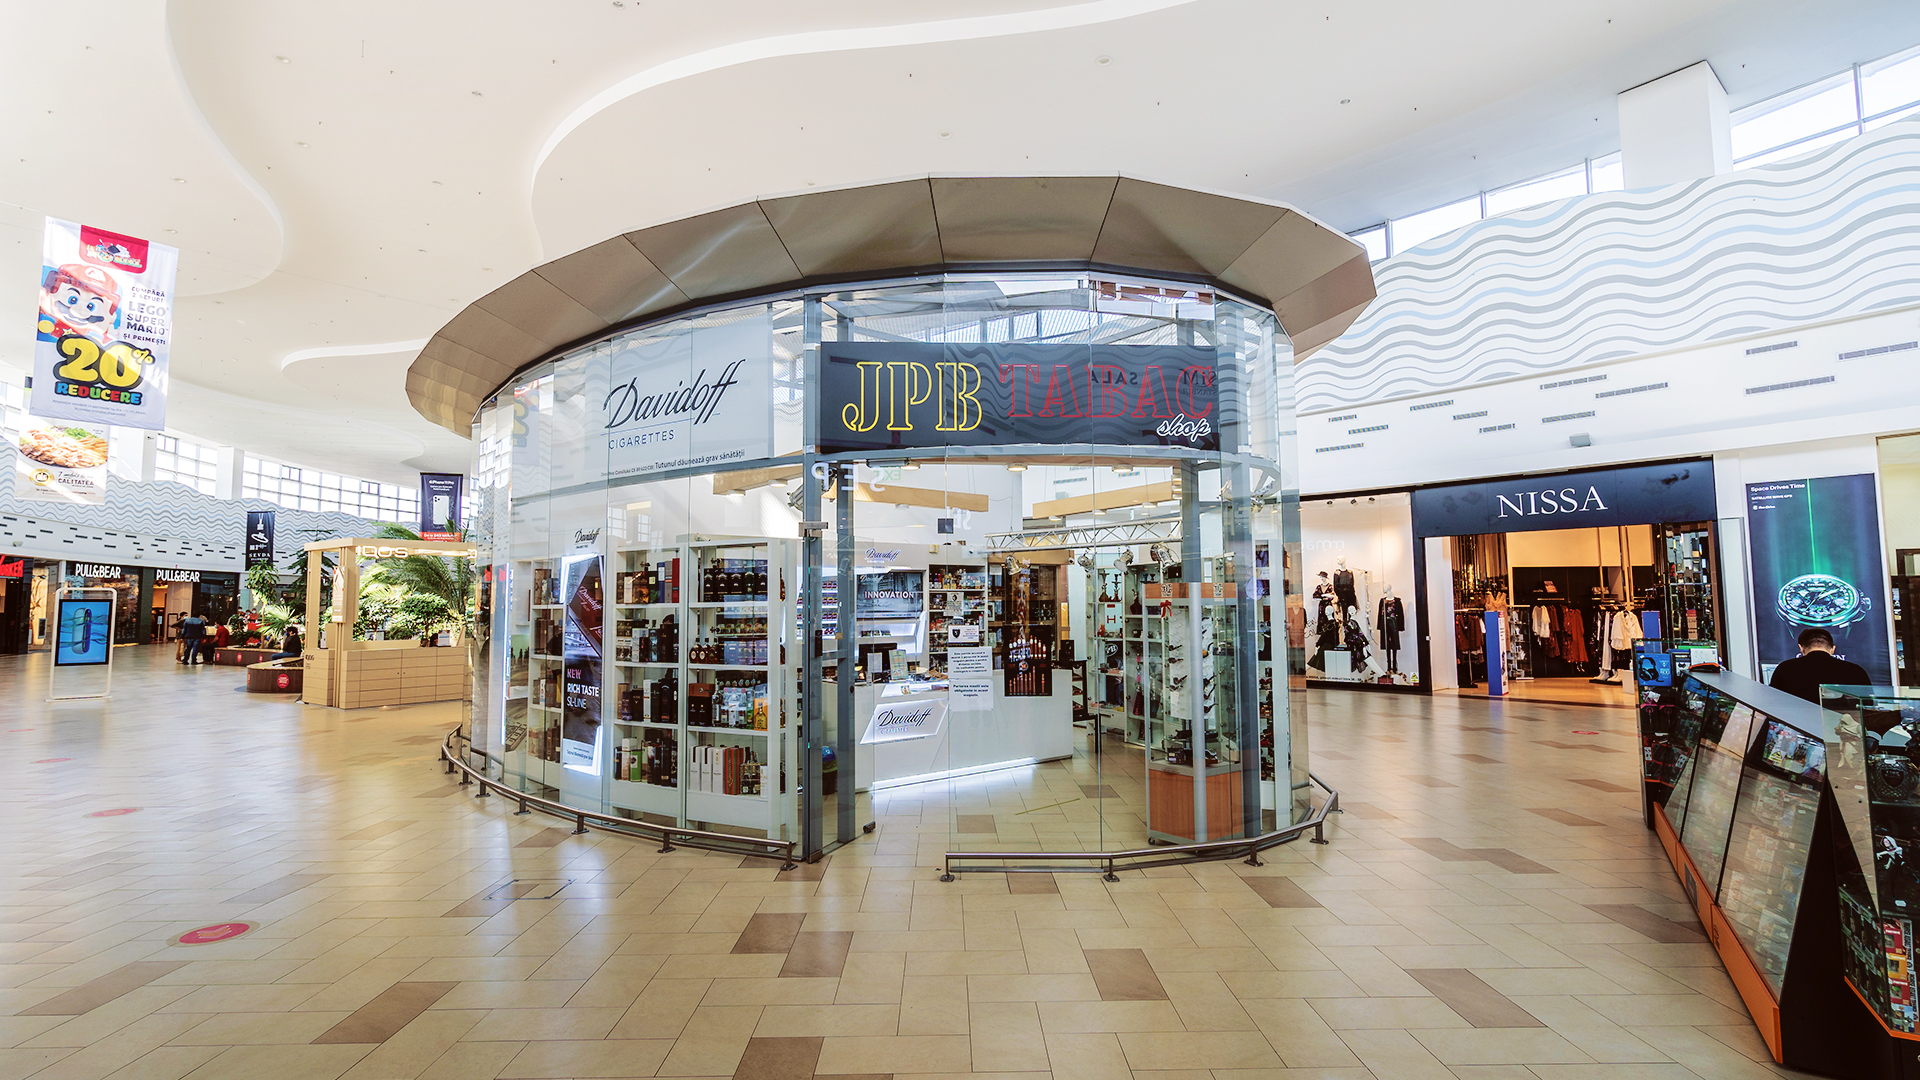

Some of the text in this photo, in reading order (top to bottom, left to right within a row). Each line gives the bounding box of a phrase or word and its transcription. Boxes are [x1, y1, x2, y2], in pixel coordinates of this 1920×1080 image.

[126, 313, 165, 327] SUPER
[55, 382, 142, 405] REDUCERE
[603, 358, 746, 429] Davidoff
[841, 361, 1213, 432] JPB TABAC
[1156, 413, 1211, 442] shop
[608, 429, 676, 450] CIGARETTES
[655, 459, 677, 469] Tutunul
[706, 454, 718, 465] grav
[58, 478, 94, 486] CALITATEA
[1496, 485, 1608, 519] NISSA
[356, 545, 409, 560] IQOS
[864, 546, 902, 562] Davidoff
[75, 563, 122, 579] PULL&BEAR
[156, 569, 200, 583] PULL&BEAR
[864, 590, 914, 599] INNOVATION
[566, 668, 582, 680] NEW
[566, 683, 600, 697] RICH TASTE
[877, 707, 934, 728] Davidoff
